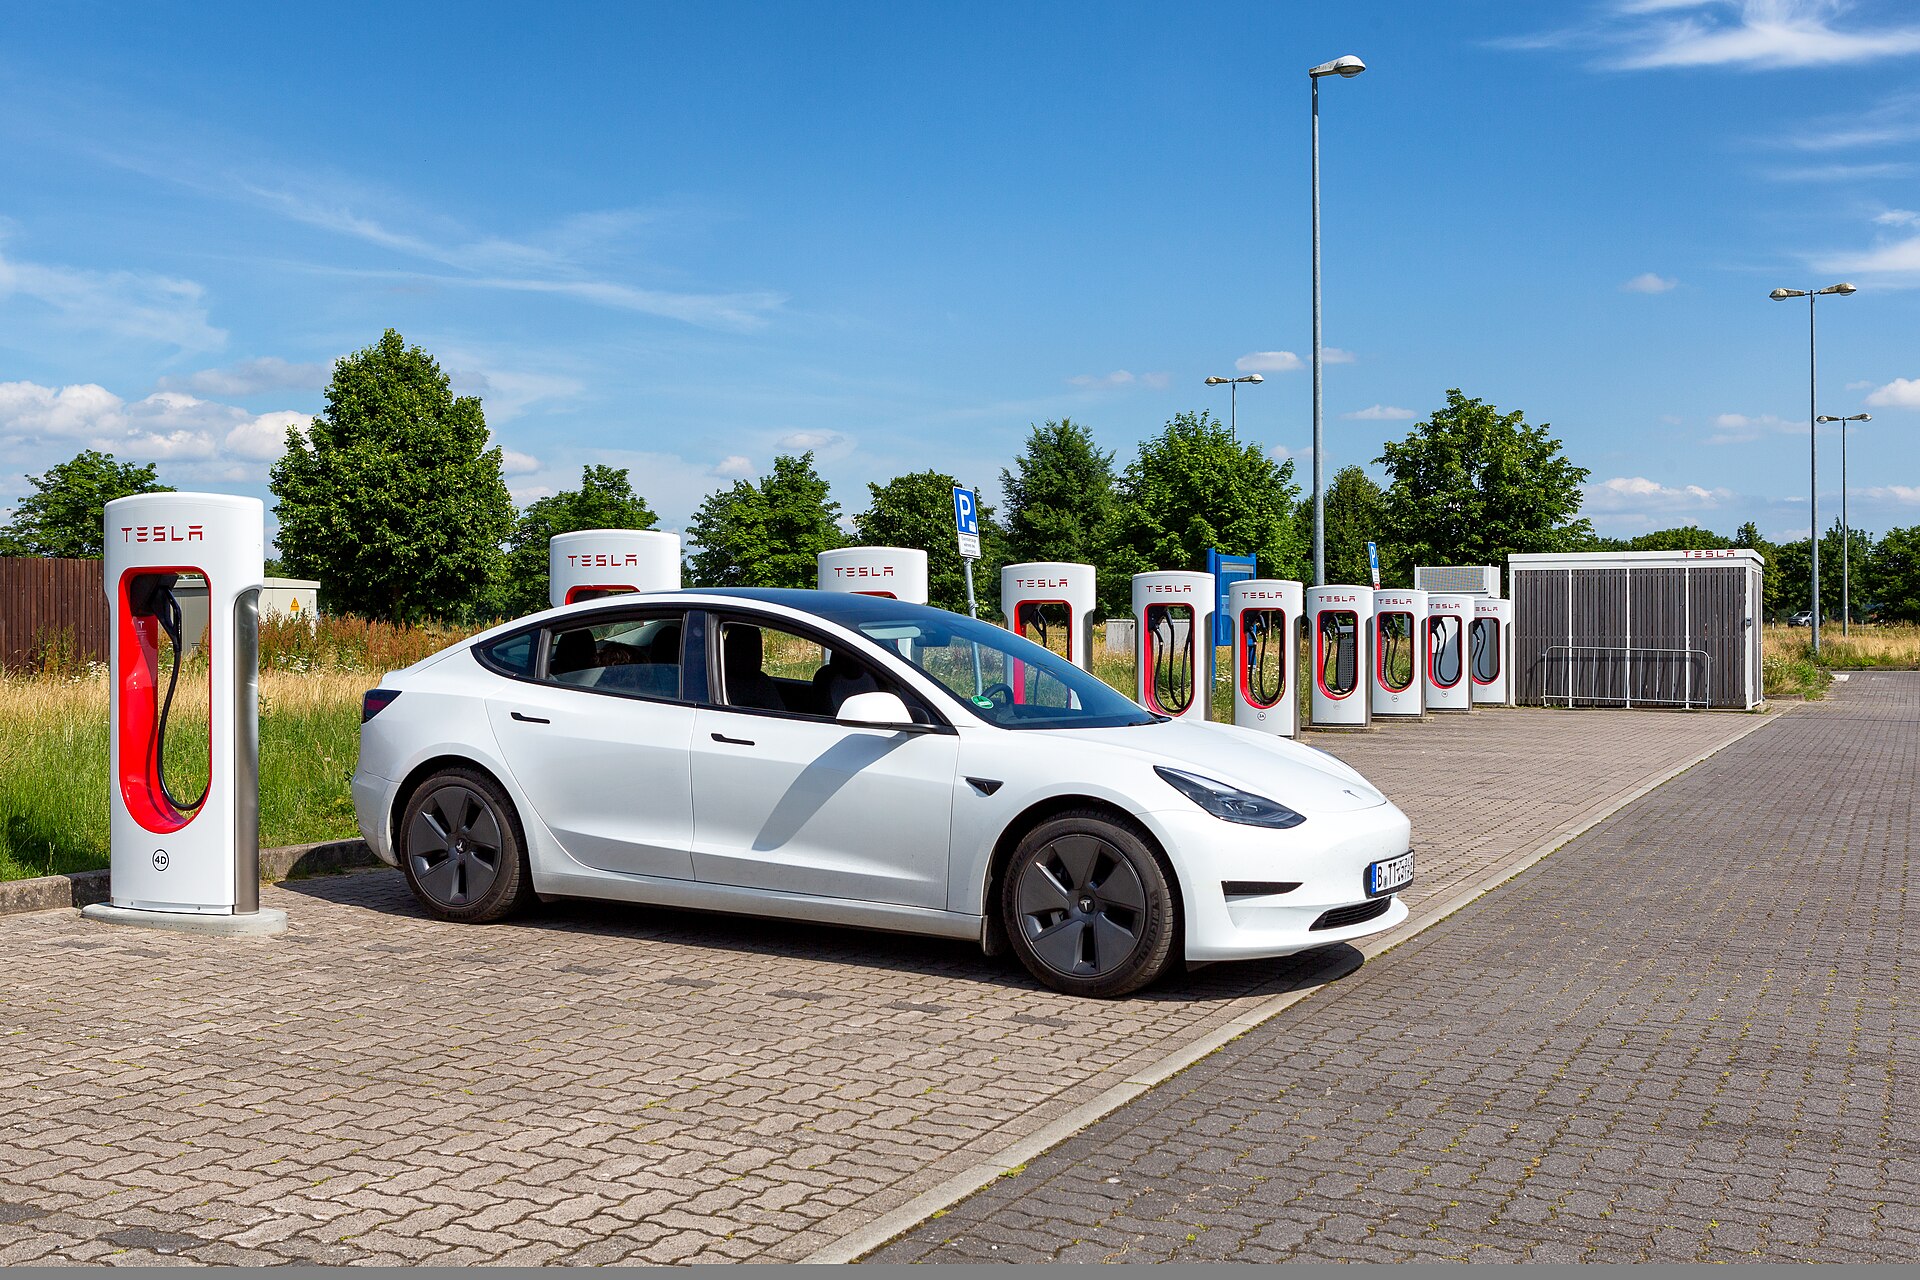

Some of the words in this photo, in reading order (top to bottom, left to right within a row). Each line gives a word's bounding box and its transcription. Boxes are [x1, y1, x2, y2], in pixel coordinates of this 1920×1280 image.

[958, 494, 971, 528] P
[120, 525, 203, 543] TESLA
[1683, 549, 1735, 558] TESLA
[567, 554, 637, 567] TESLA
[834, 566, 894, 578] TESLA
[1016, 578, 1068, 588] TESLA
[1145, 584, 1192, 593] TESLA
[154, 855, 167, 865] 4D
[1377, 866, 1383, 888] B
